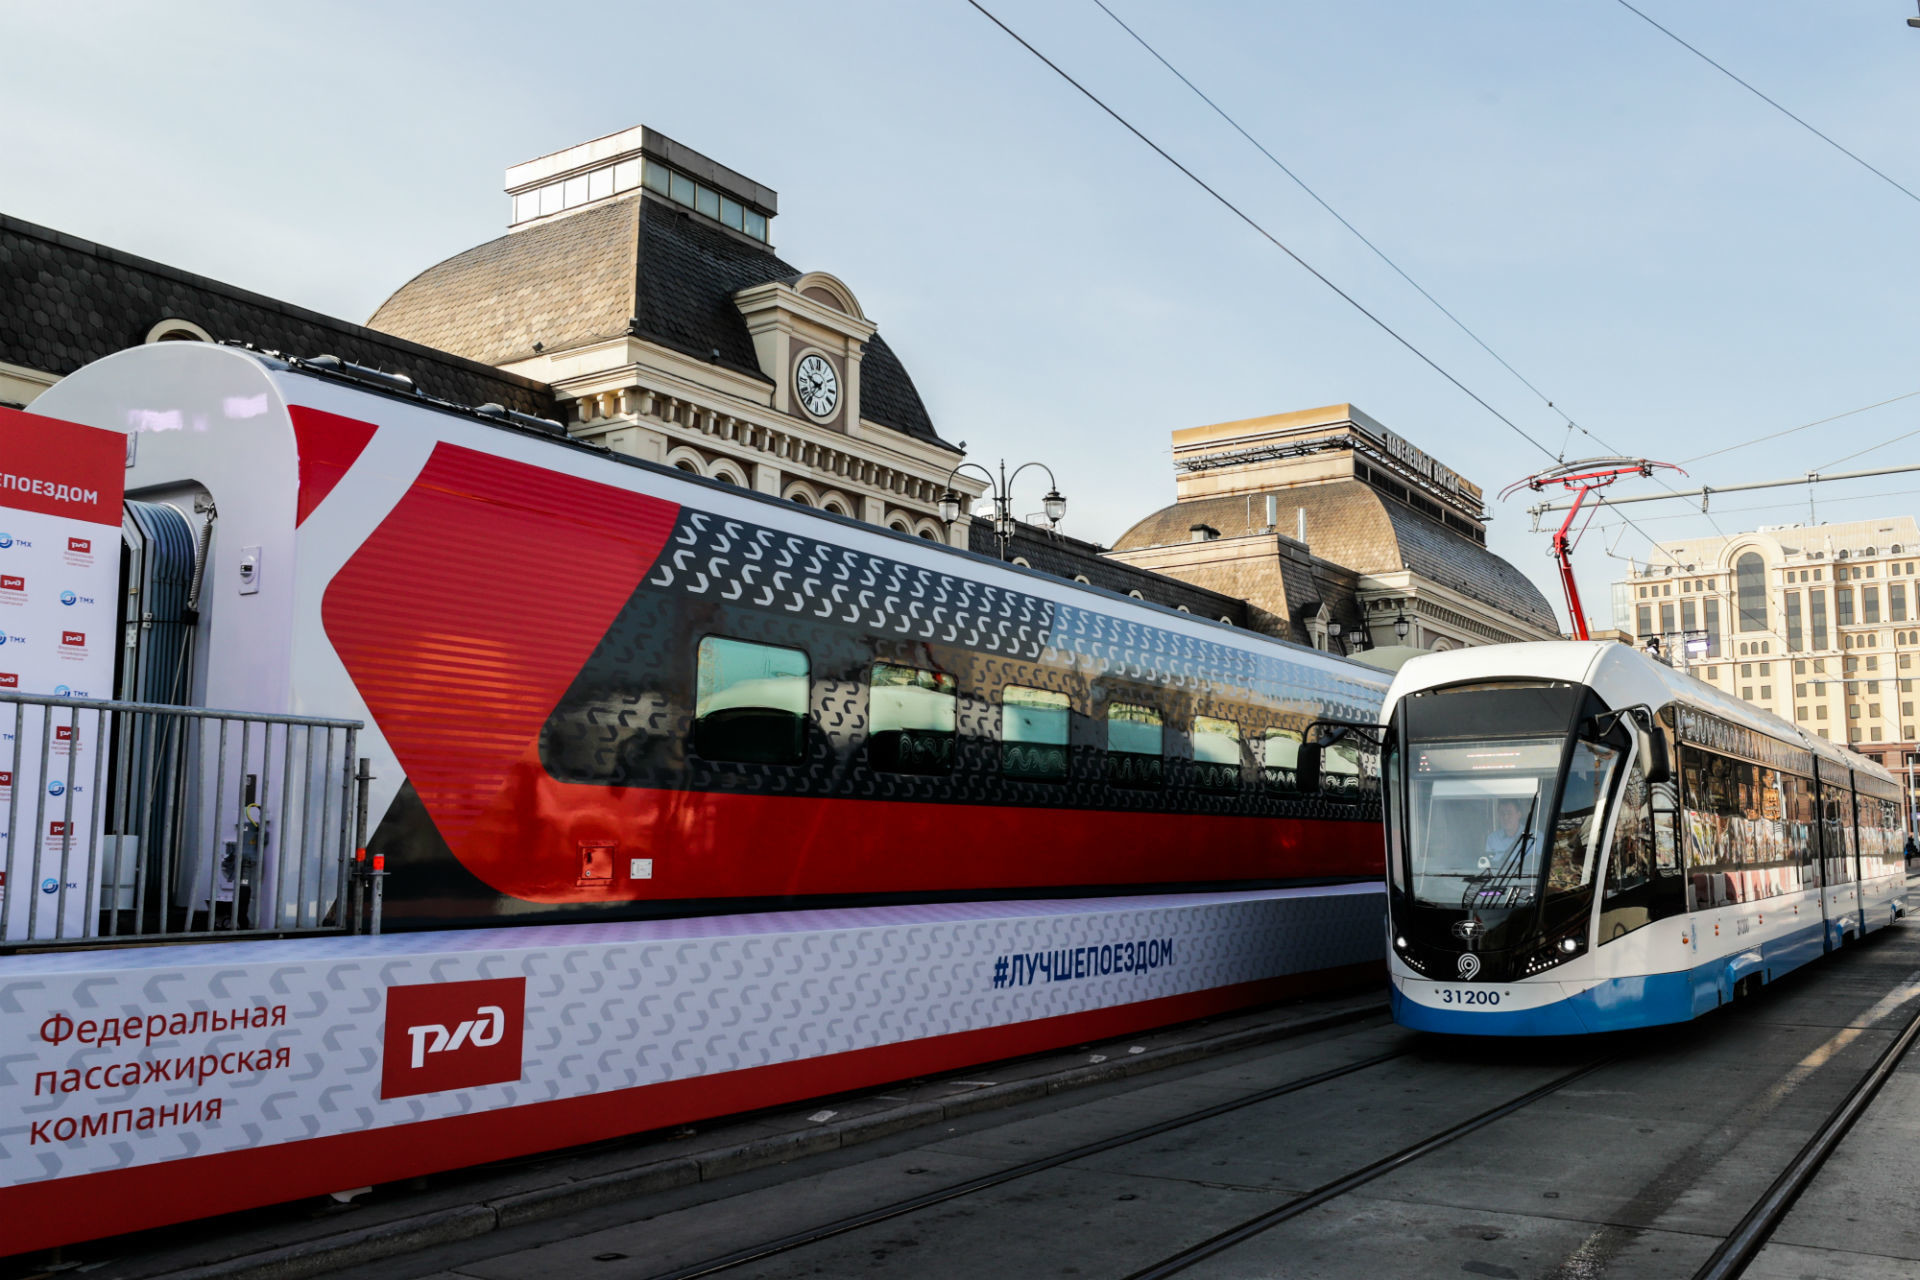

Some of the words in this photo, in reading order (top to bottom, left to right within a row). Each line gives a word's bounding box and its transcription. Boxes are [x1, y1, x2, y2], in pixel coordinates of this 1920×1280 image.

[0, 473, 98, 505] ПОЕЗДОМ
[993, 937, 1173, 989] #ЛУЧШЕПОЕЗДОМ
[1442, 989, 1500, 1005] 31200
[39, 1005, 287, 1048] Федеральная
[34, 1047, 291, 1096] пассажирская
[30, 1098, 222, 1145] компания
